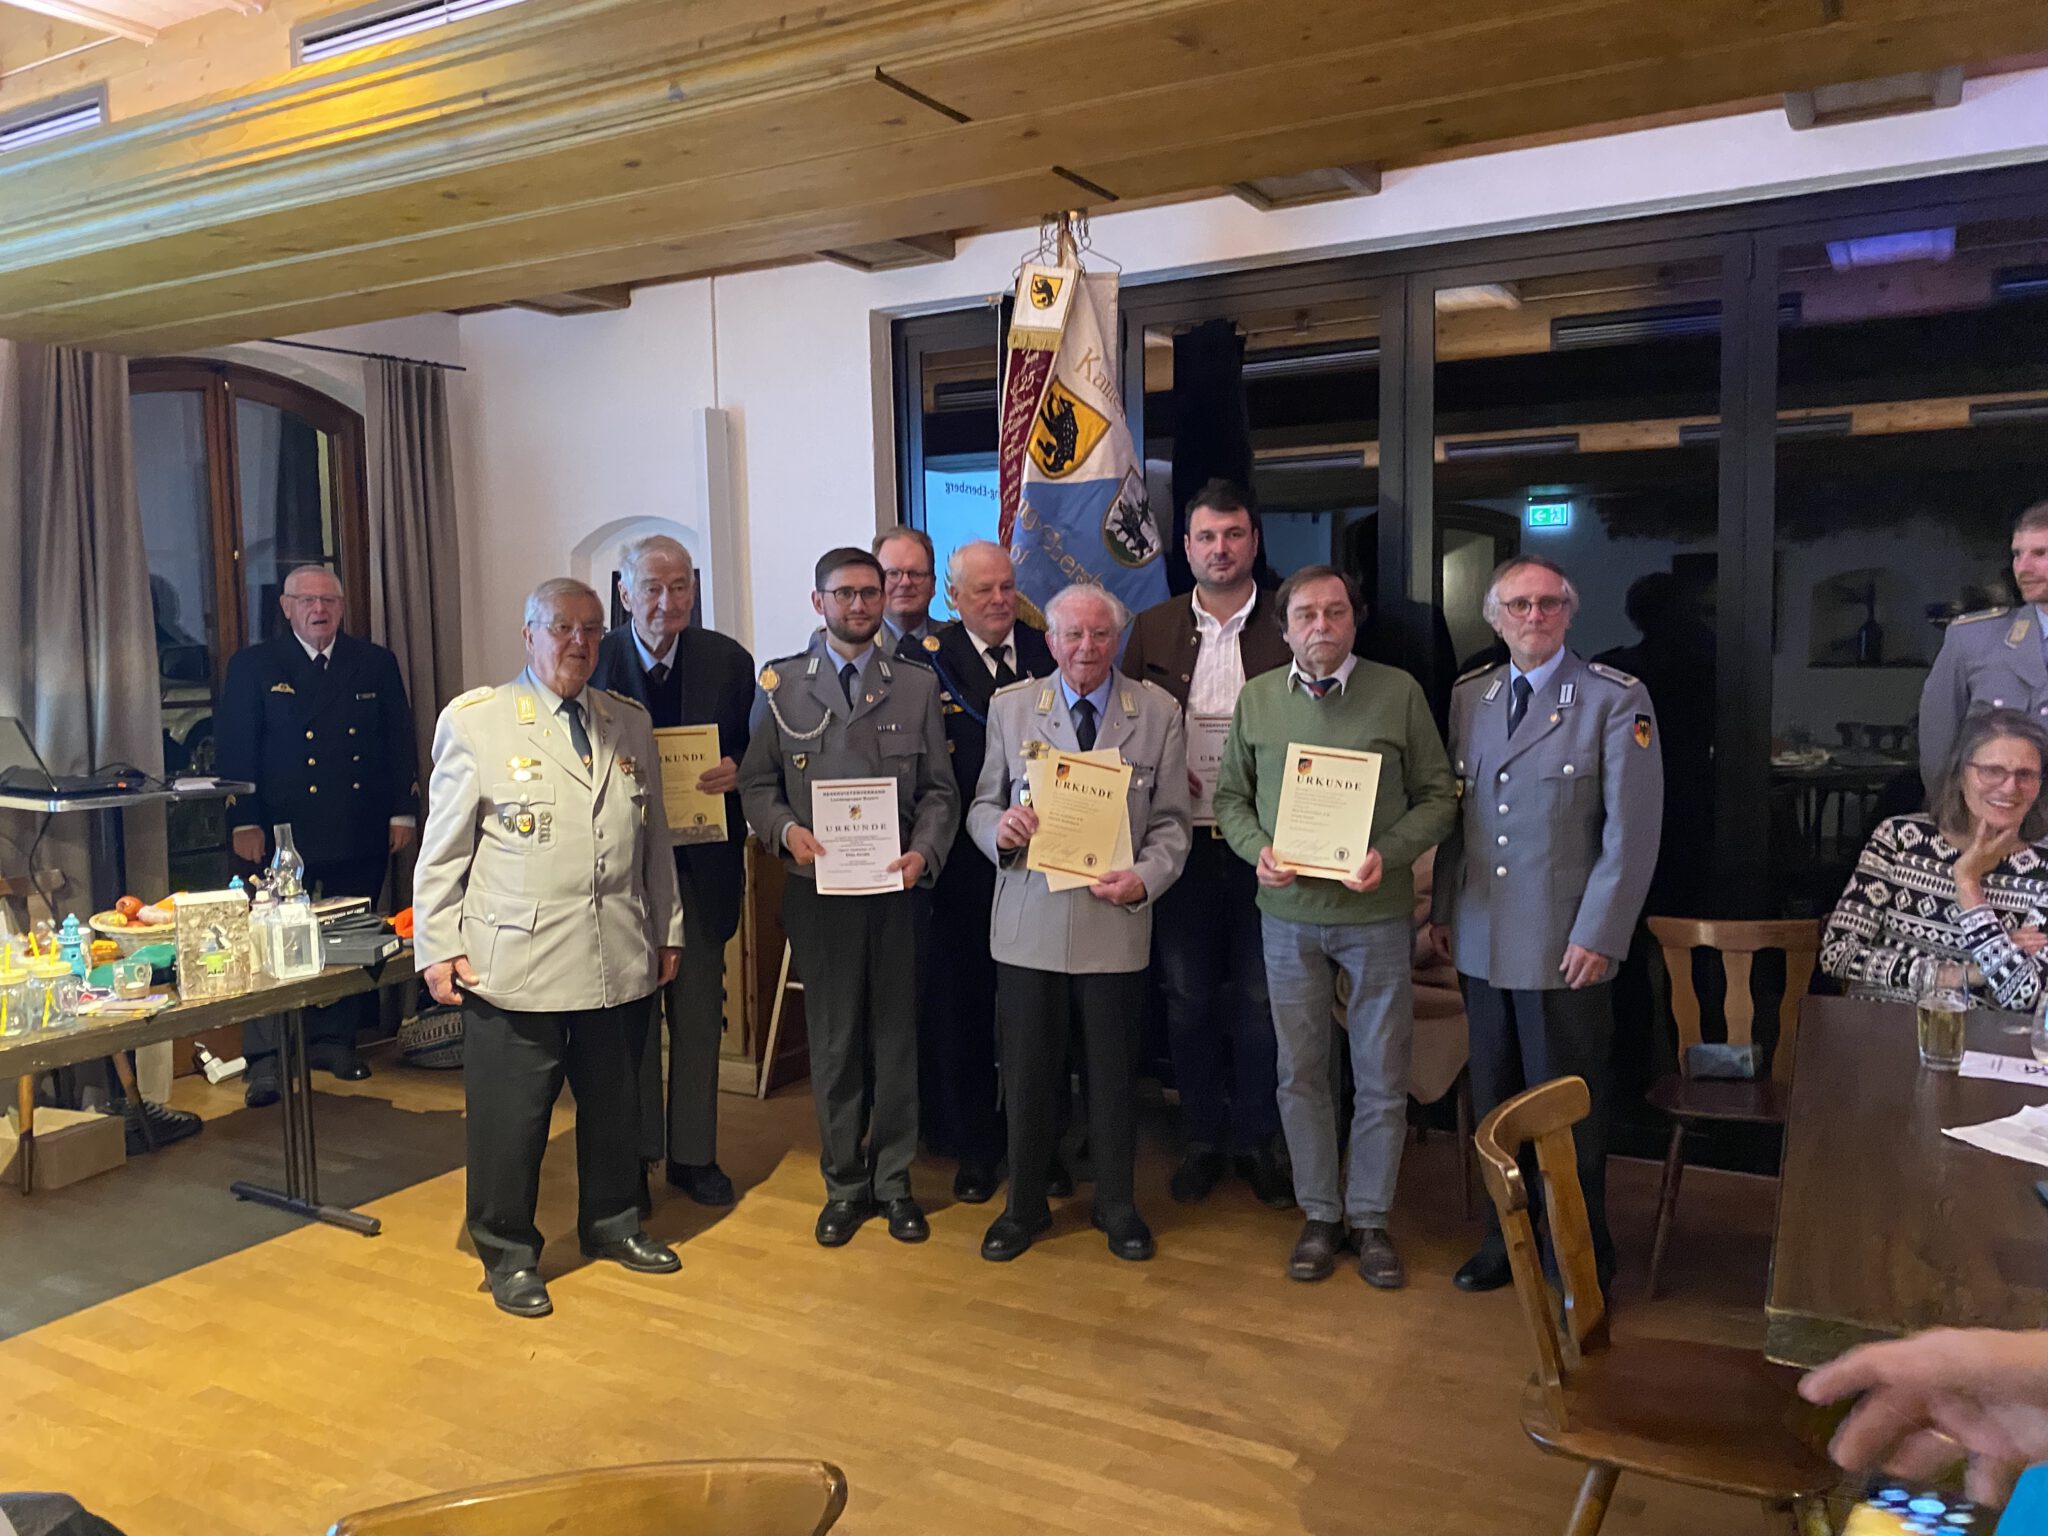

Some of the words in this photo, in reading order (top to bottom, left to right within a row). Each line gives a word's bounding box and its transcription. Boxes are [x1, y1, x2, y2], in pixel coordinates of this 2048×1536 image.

[1055, 779, 1114, 800] URKUNDE
[1297, 775, 1362, 791] URKUNDE
[825, 823, 887, 832] URKUNDE
